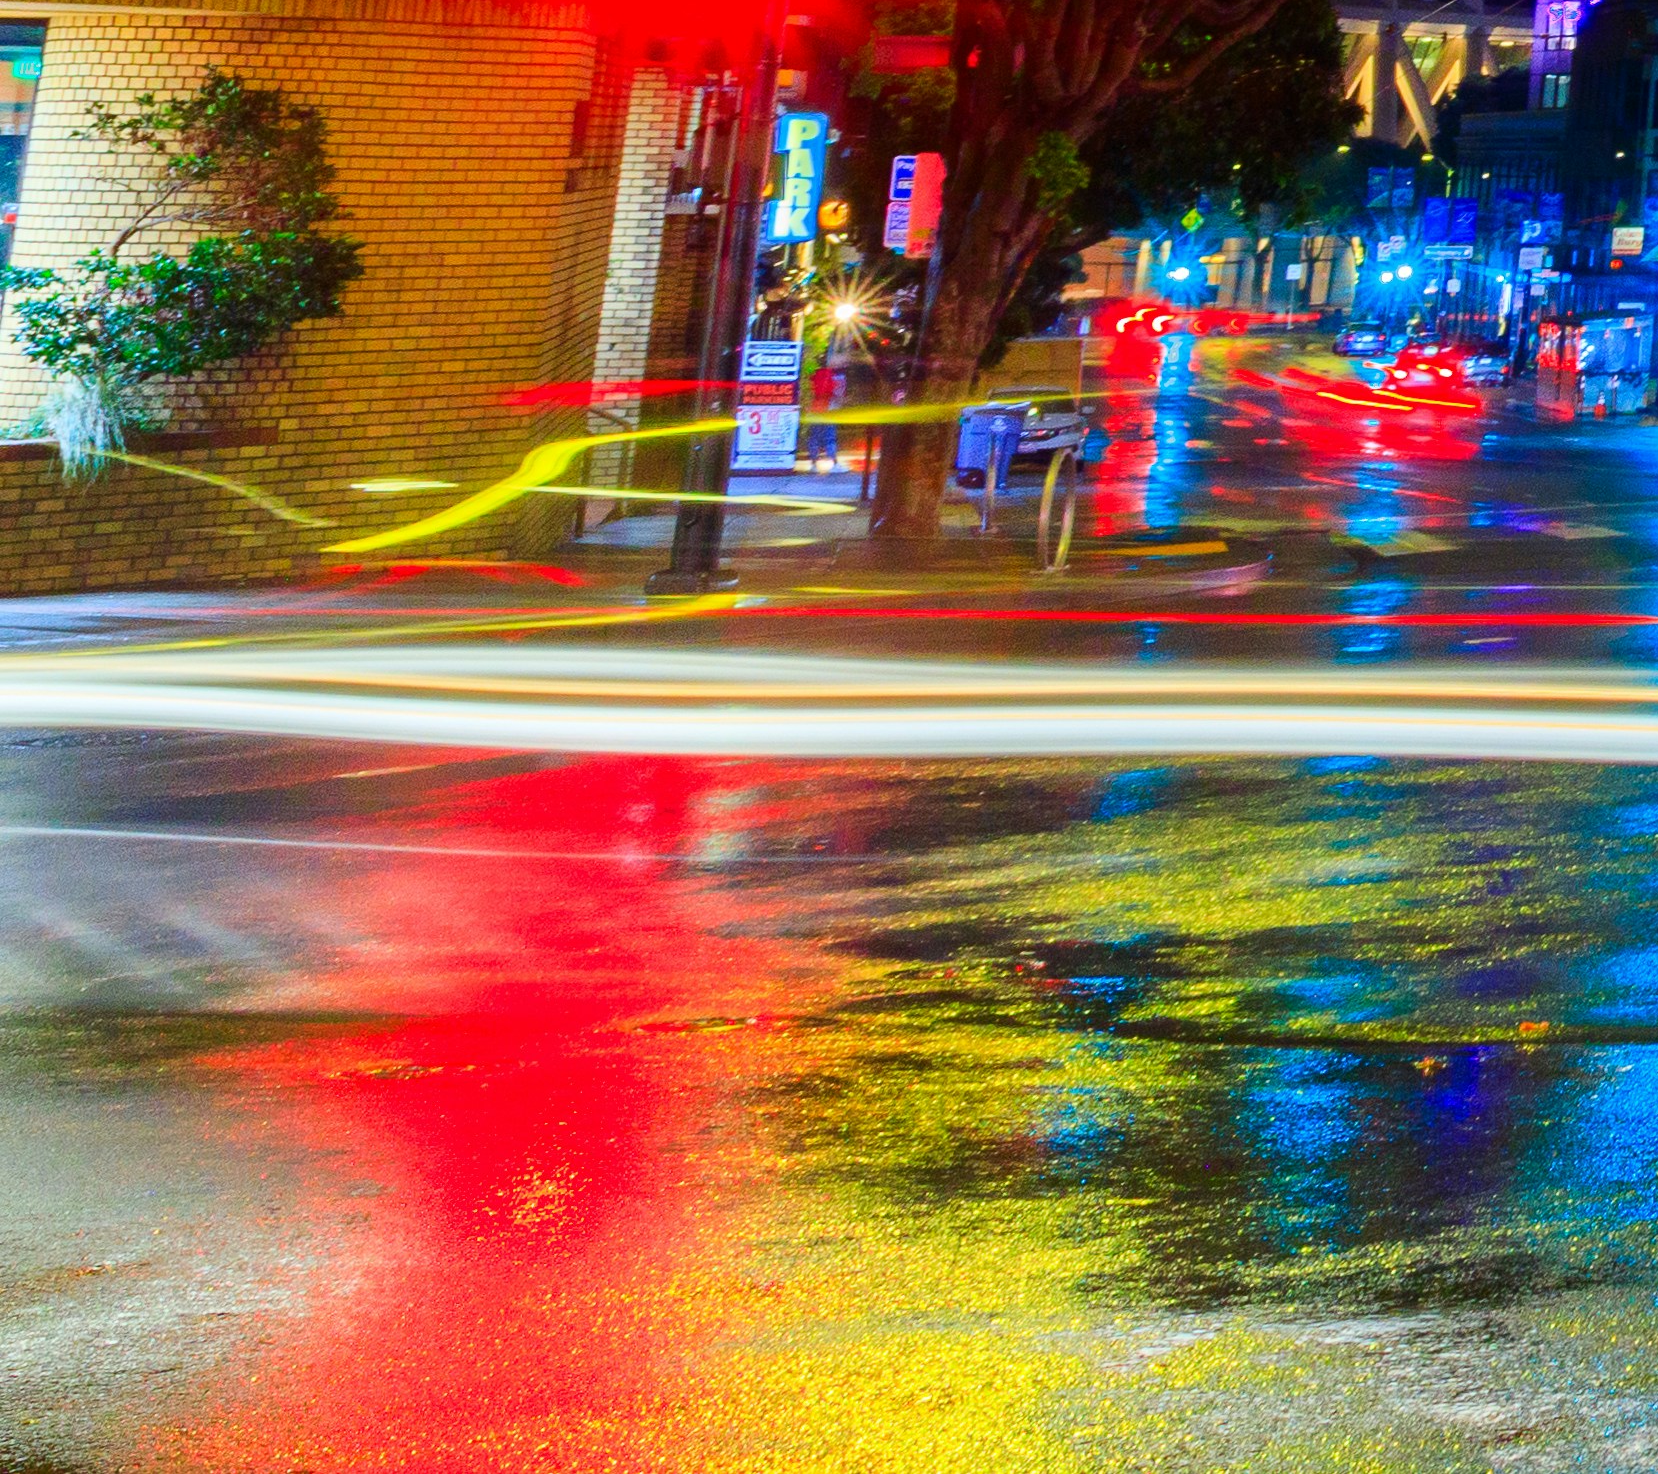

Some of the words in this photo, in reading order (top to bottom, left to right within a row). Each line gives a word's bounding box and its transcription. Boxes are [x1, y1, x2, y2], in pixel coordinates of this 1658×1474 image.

[773, 119, 820, 237] PARK
[743, 384, 794, 396] PUBLIC
[748, 411, 761, 435] 3
